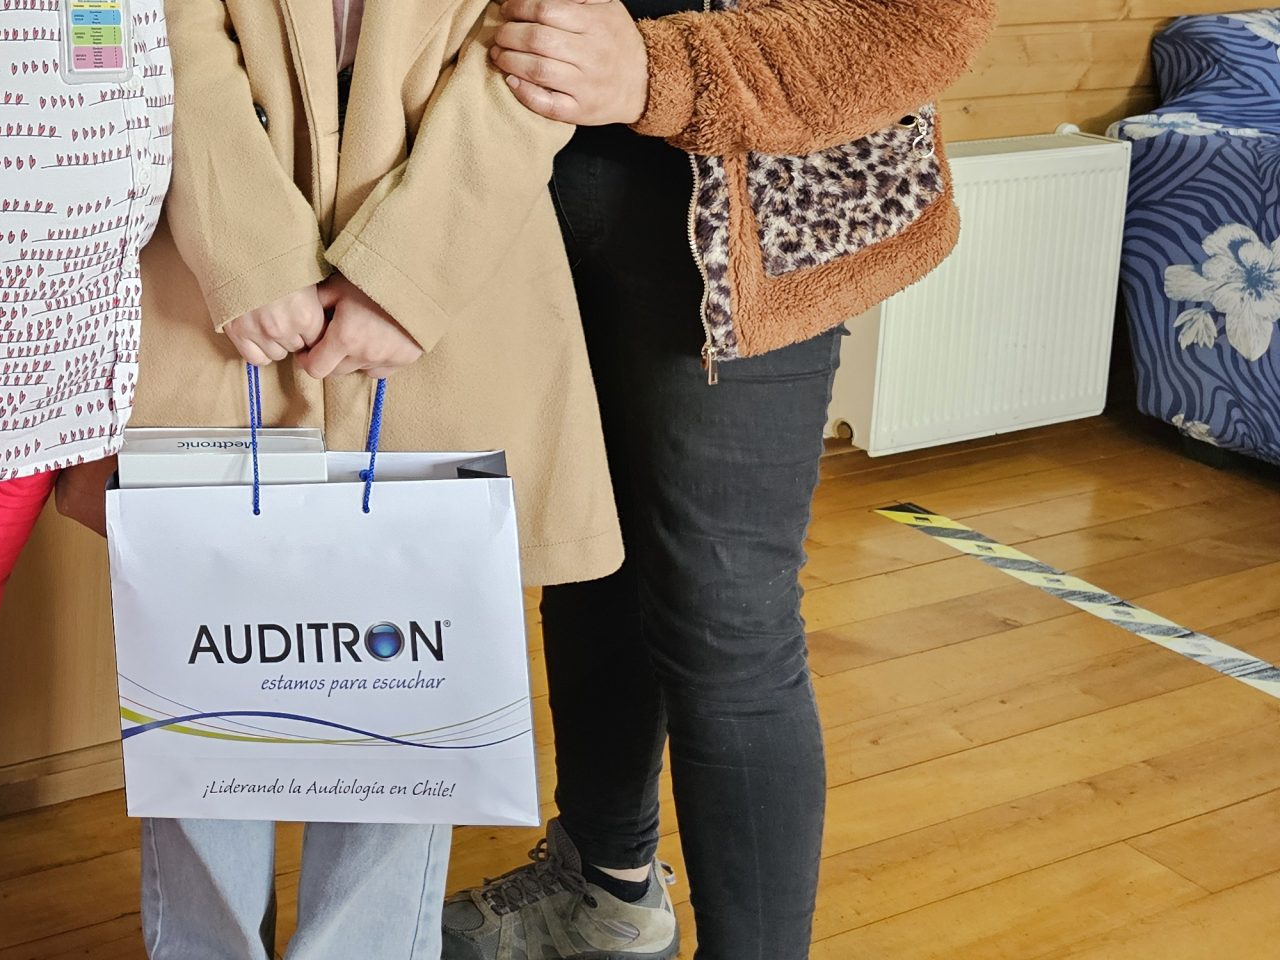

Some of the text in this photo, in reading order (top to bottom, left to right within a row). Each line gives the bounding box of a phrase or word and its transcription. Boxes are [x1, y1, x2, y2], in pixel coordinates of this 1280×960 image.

[260, 670, 445, 697] estamos para escuchar
[202, 778, 456, 801] ¡Liderando la Audiología en Chile!
